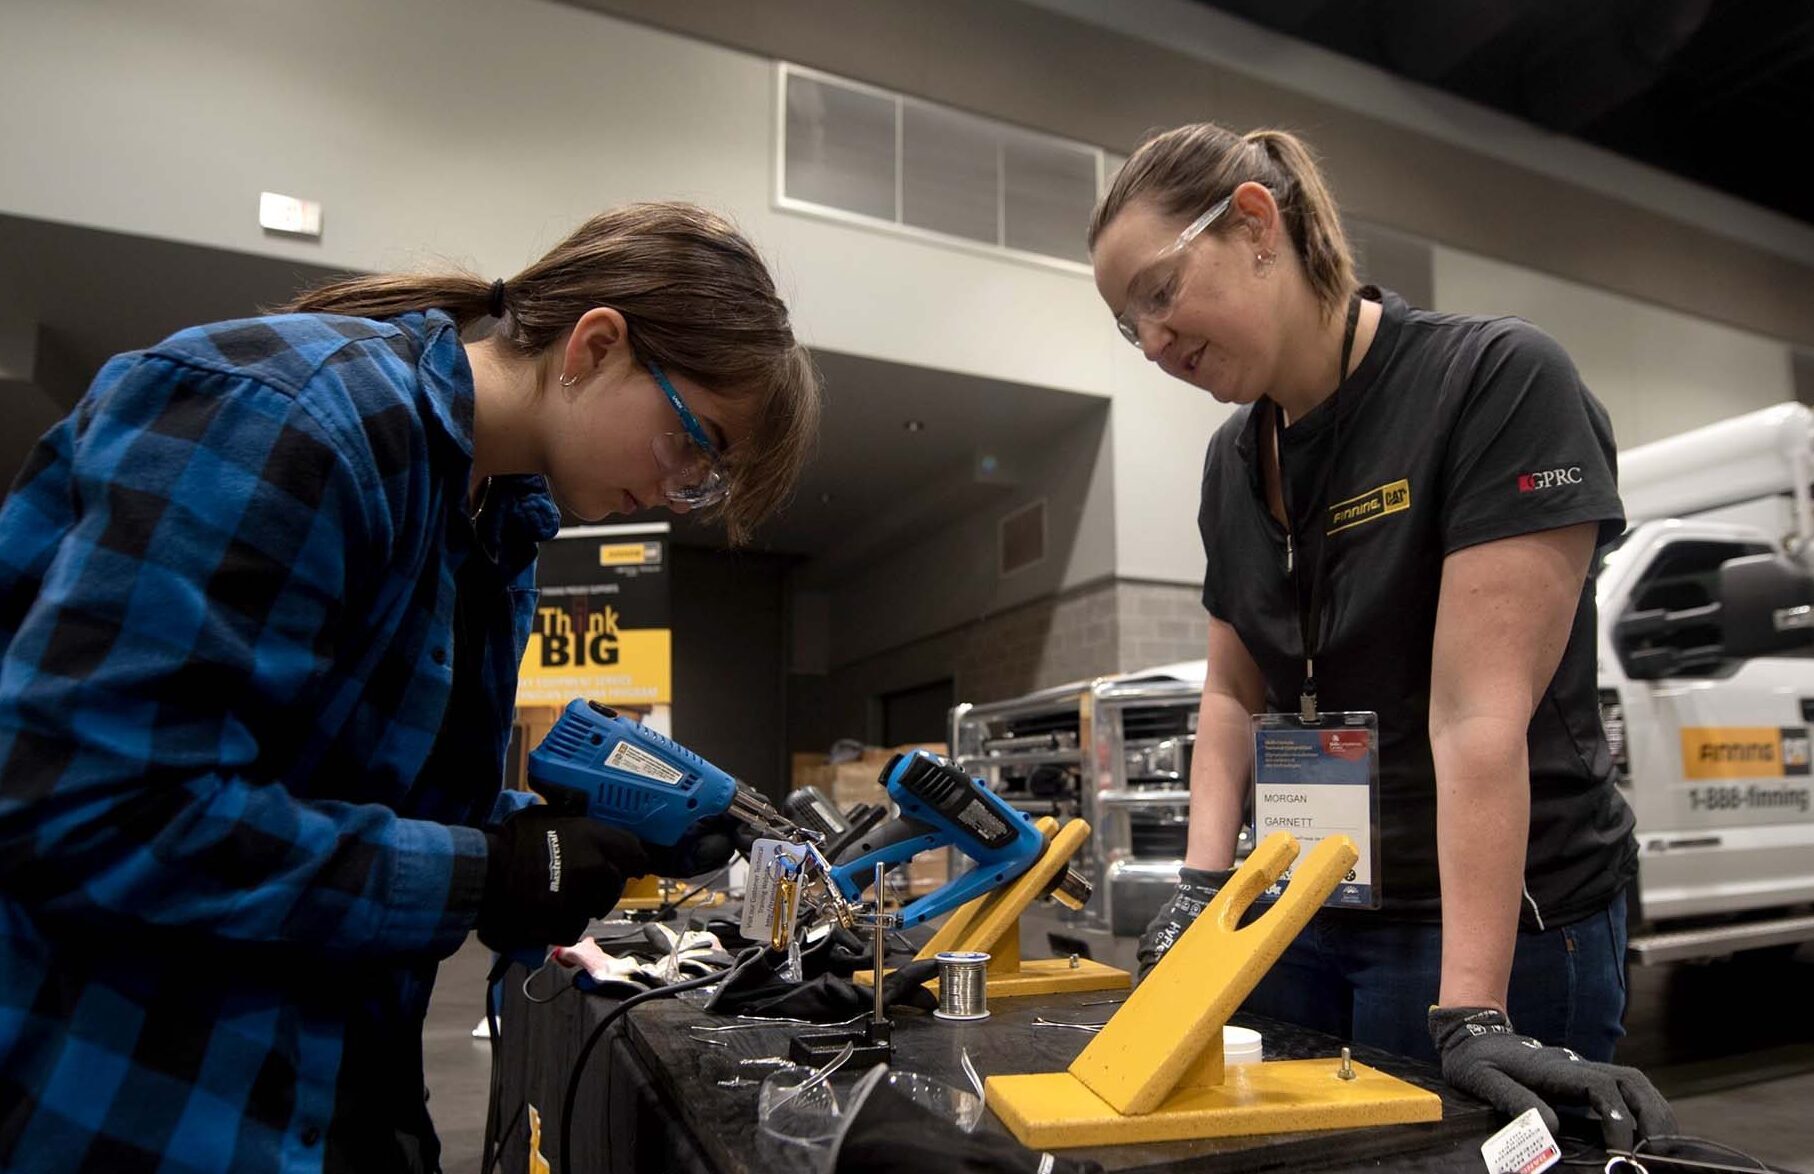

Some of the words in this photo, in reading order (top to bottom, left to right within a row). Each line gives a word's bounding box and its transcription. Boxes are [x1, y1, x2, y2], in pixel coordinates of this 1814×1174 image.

[1530, 467, 1582, 490] GPRC
[1385, 487, 1408, 506] CAT
[541, 634, 619, 667] BIG
[1700, 743, 1775, 761] FINNING
[1264, 794, 1307, 803] MORGAN
[1689, 785, 1810, 812] 1-888-finning
[1264, 817, 1312, 827] GARNETT
